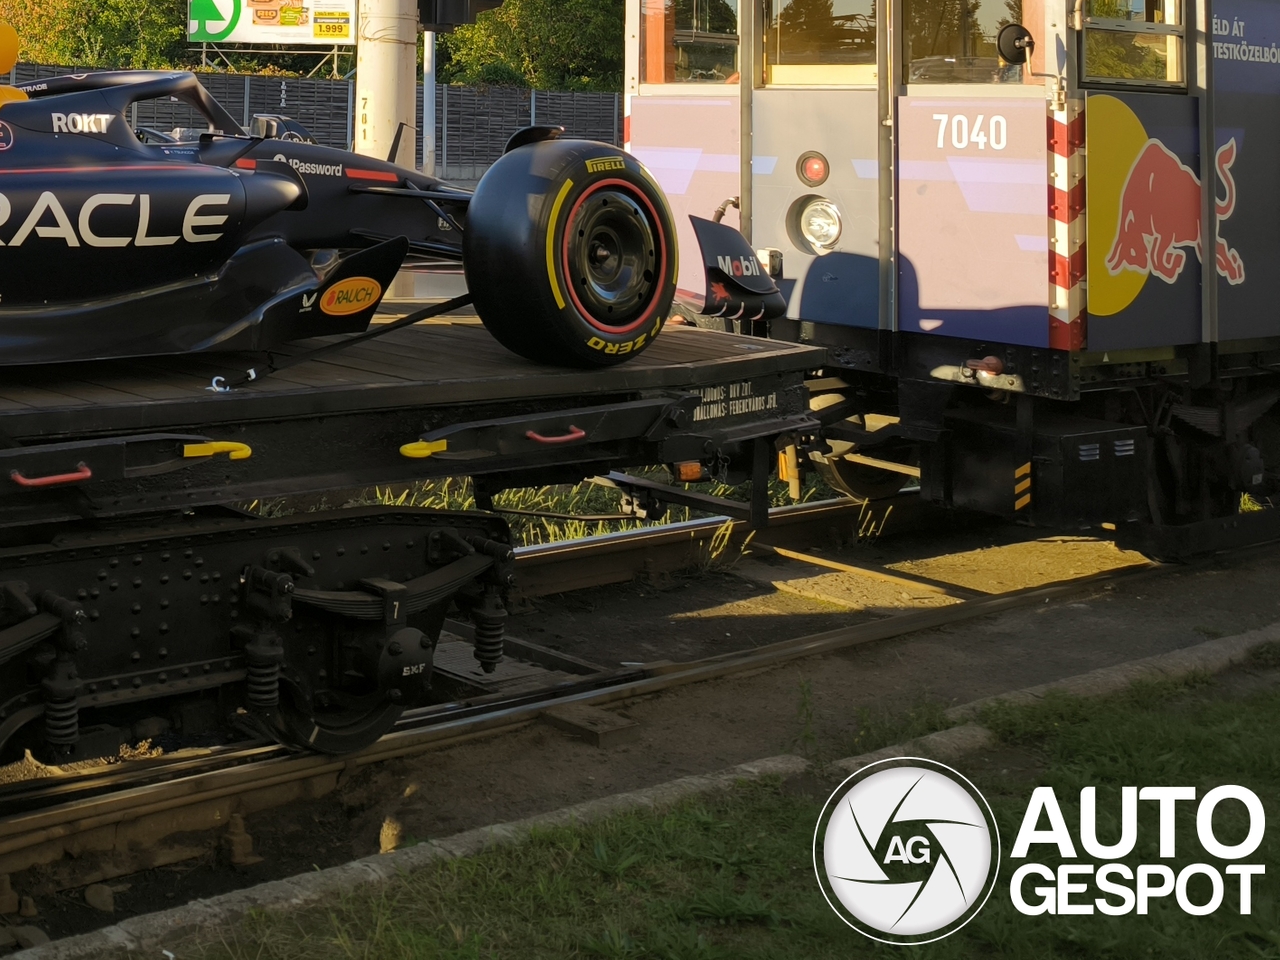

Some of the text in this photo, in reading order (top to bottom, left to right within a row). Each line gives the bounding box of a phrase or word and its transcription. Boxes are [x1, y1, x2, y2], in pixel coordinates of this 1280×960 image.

[318, 24, 343, 33] 1.999
[1212, 14, 1245, 37] ÉLD ÁT
[51, 112, 116, 134] ROKT
[932, 113, 1007, 150] 7040
[288, 158, 342, 177] 1Password
[585, 156, 625, 173] PIRELLI
[718, 256, 760, 276] Mobil
[334, 287, 374, 305] RAUCH
[586, 332, 646, 355] ZERO
[402, 663, 426, 677] SKF
